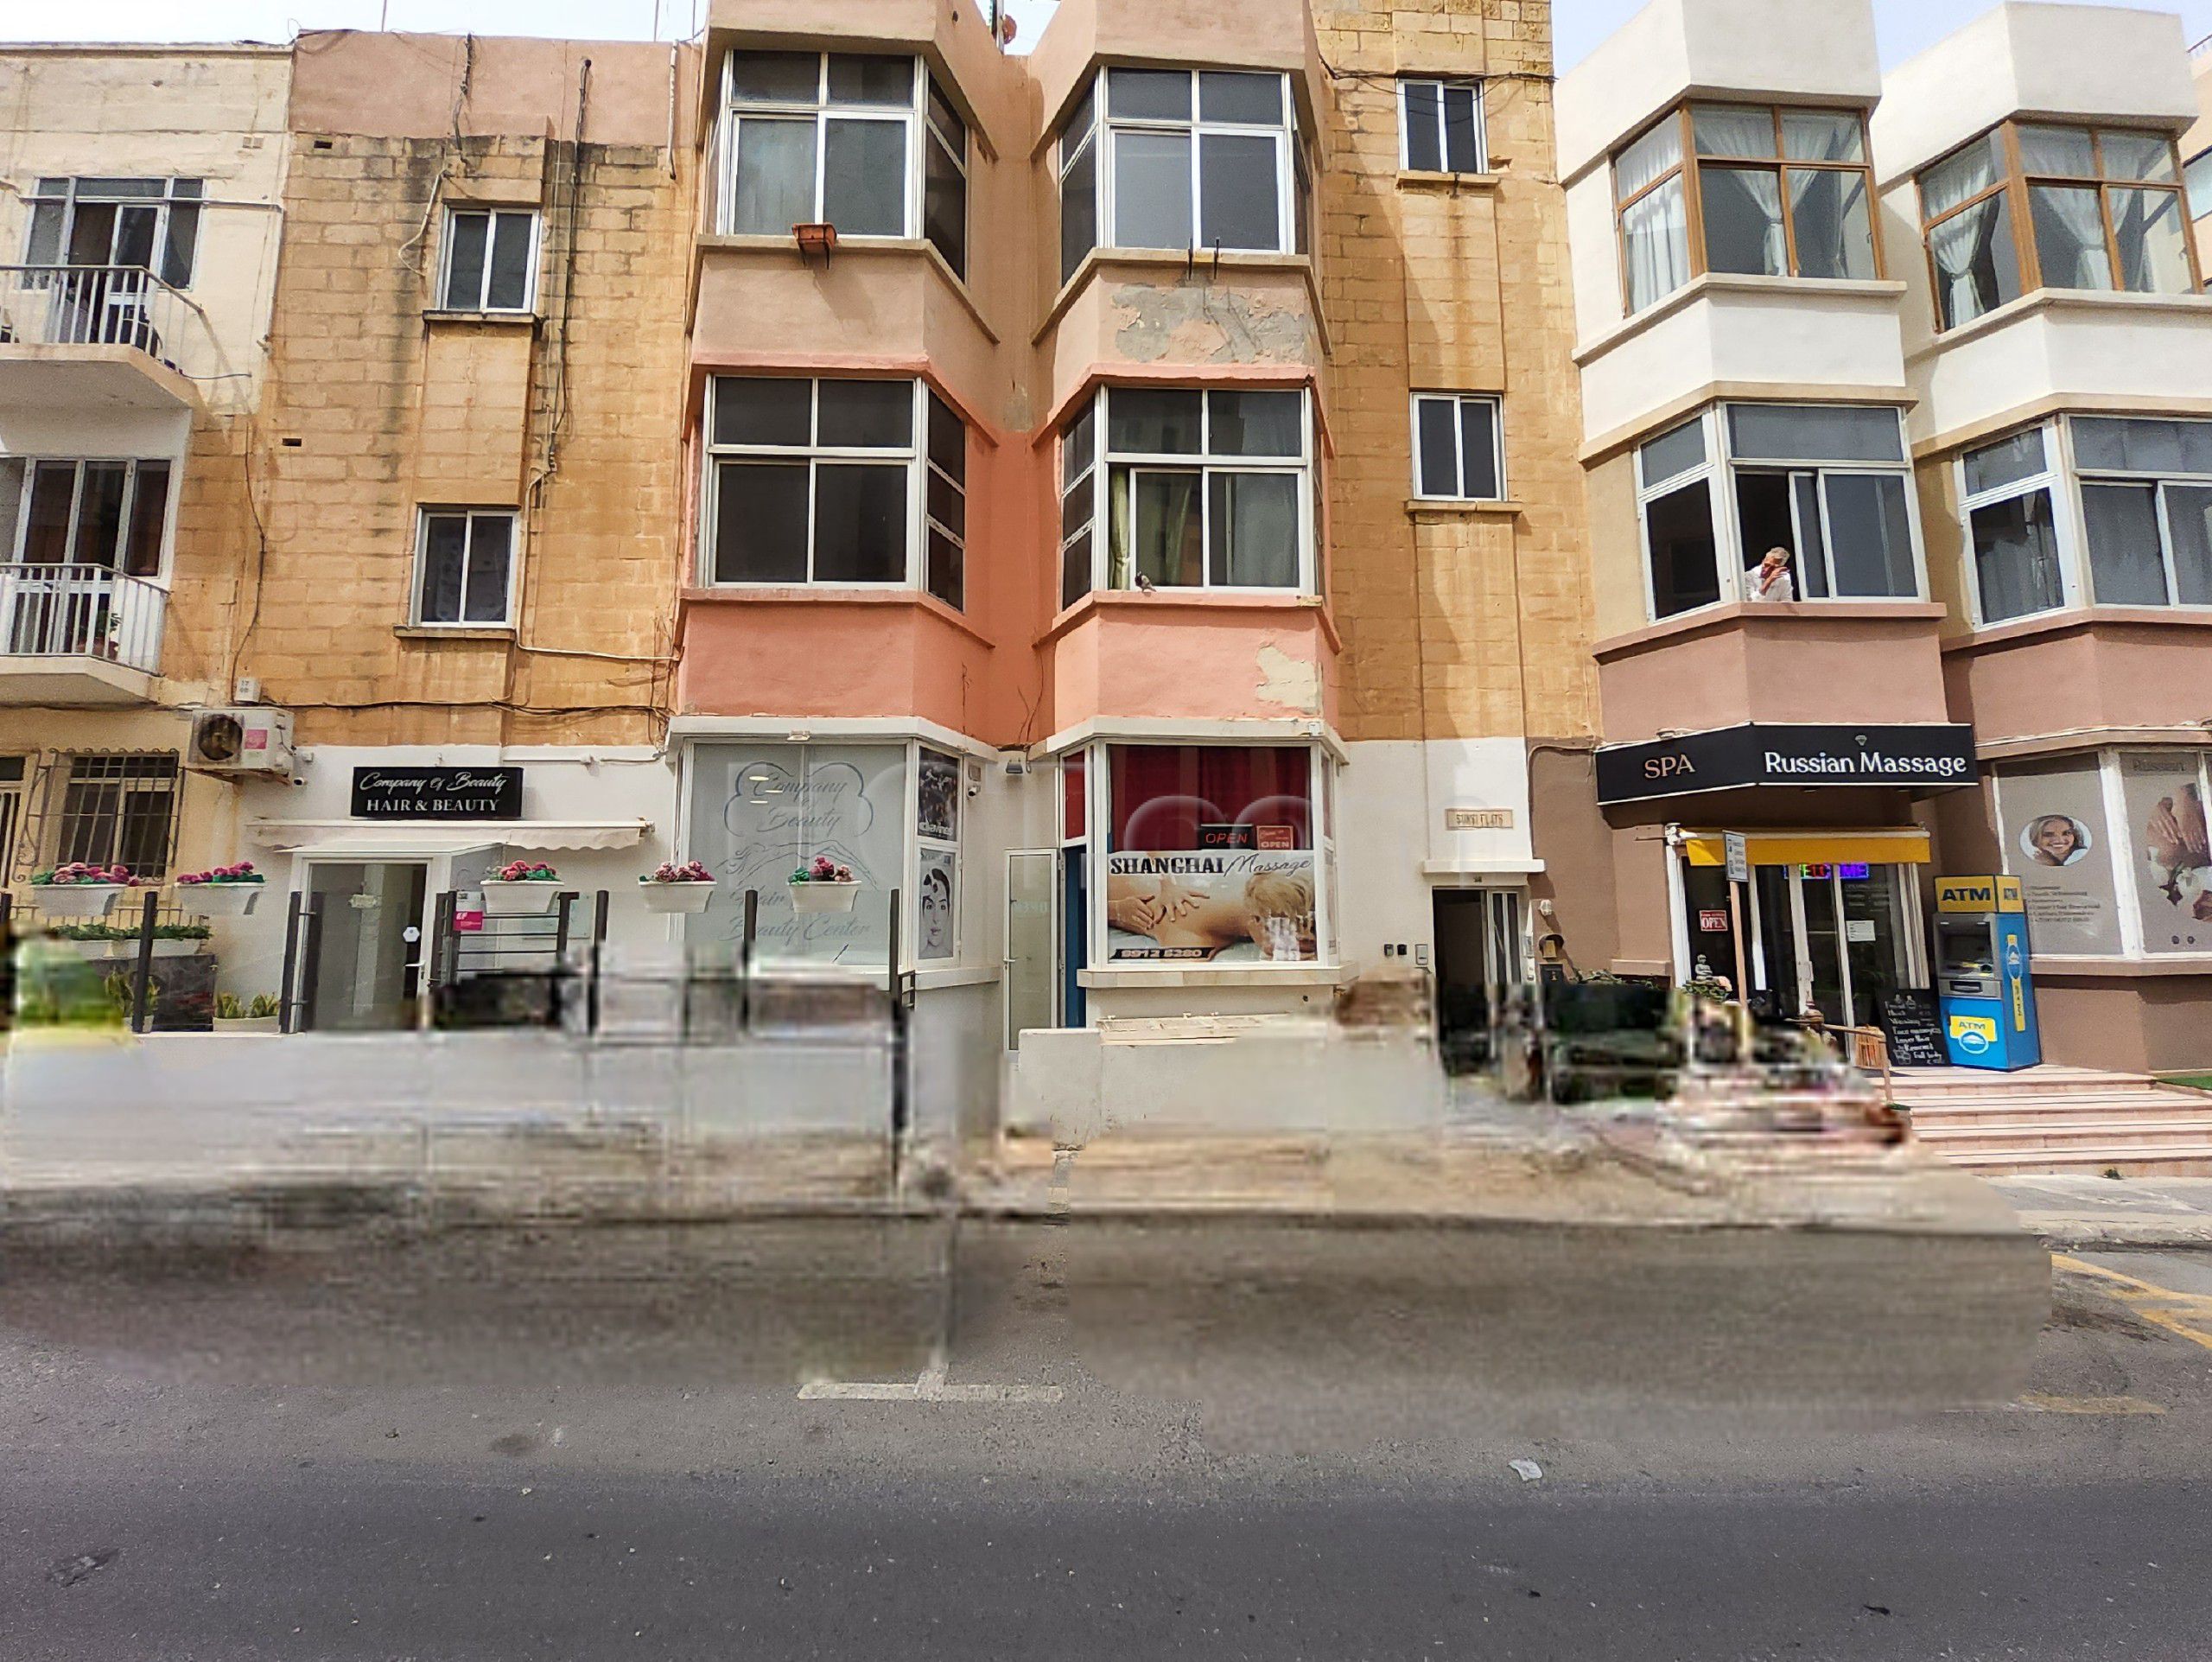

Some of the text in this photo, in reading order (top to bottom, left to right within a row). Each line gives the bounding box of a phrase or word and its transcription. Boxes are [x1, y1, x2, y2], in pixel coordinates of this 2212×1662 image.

[1644, 754, 1695, 779] SPA
[1764, 752, 1967, 776] Russian Massage
[359, 772, 426, 795] Company
[447, 771, 511, 795] Beauty
[366, 799, 499, 812] HAIR & BEAUTY
[1205, 832, 1249, 844] OPEN
[1110, 853, 1312, 877] SHANGHAI Massage
[1941, 888, 1991, 901] ATM
[719, 915, 800, 946] Bauty
[1701, 917, 1726, 929] OPEN
[1958, 1021, 1986, 1030] ATM
